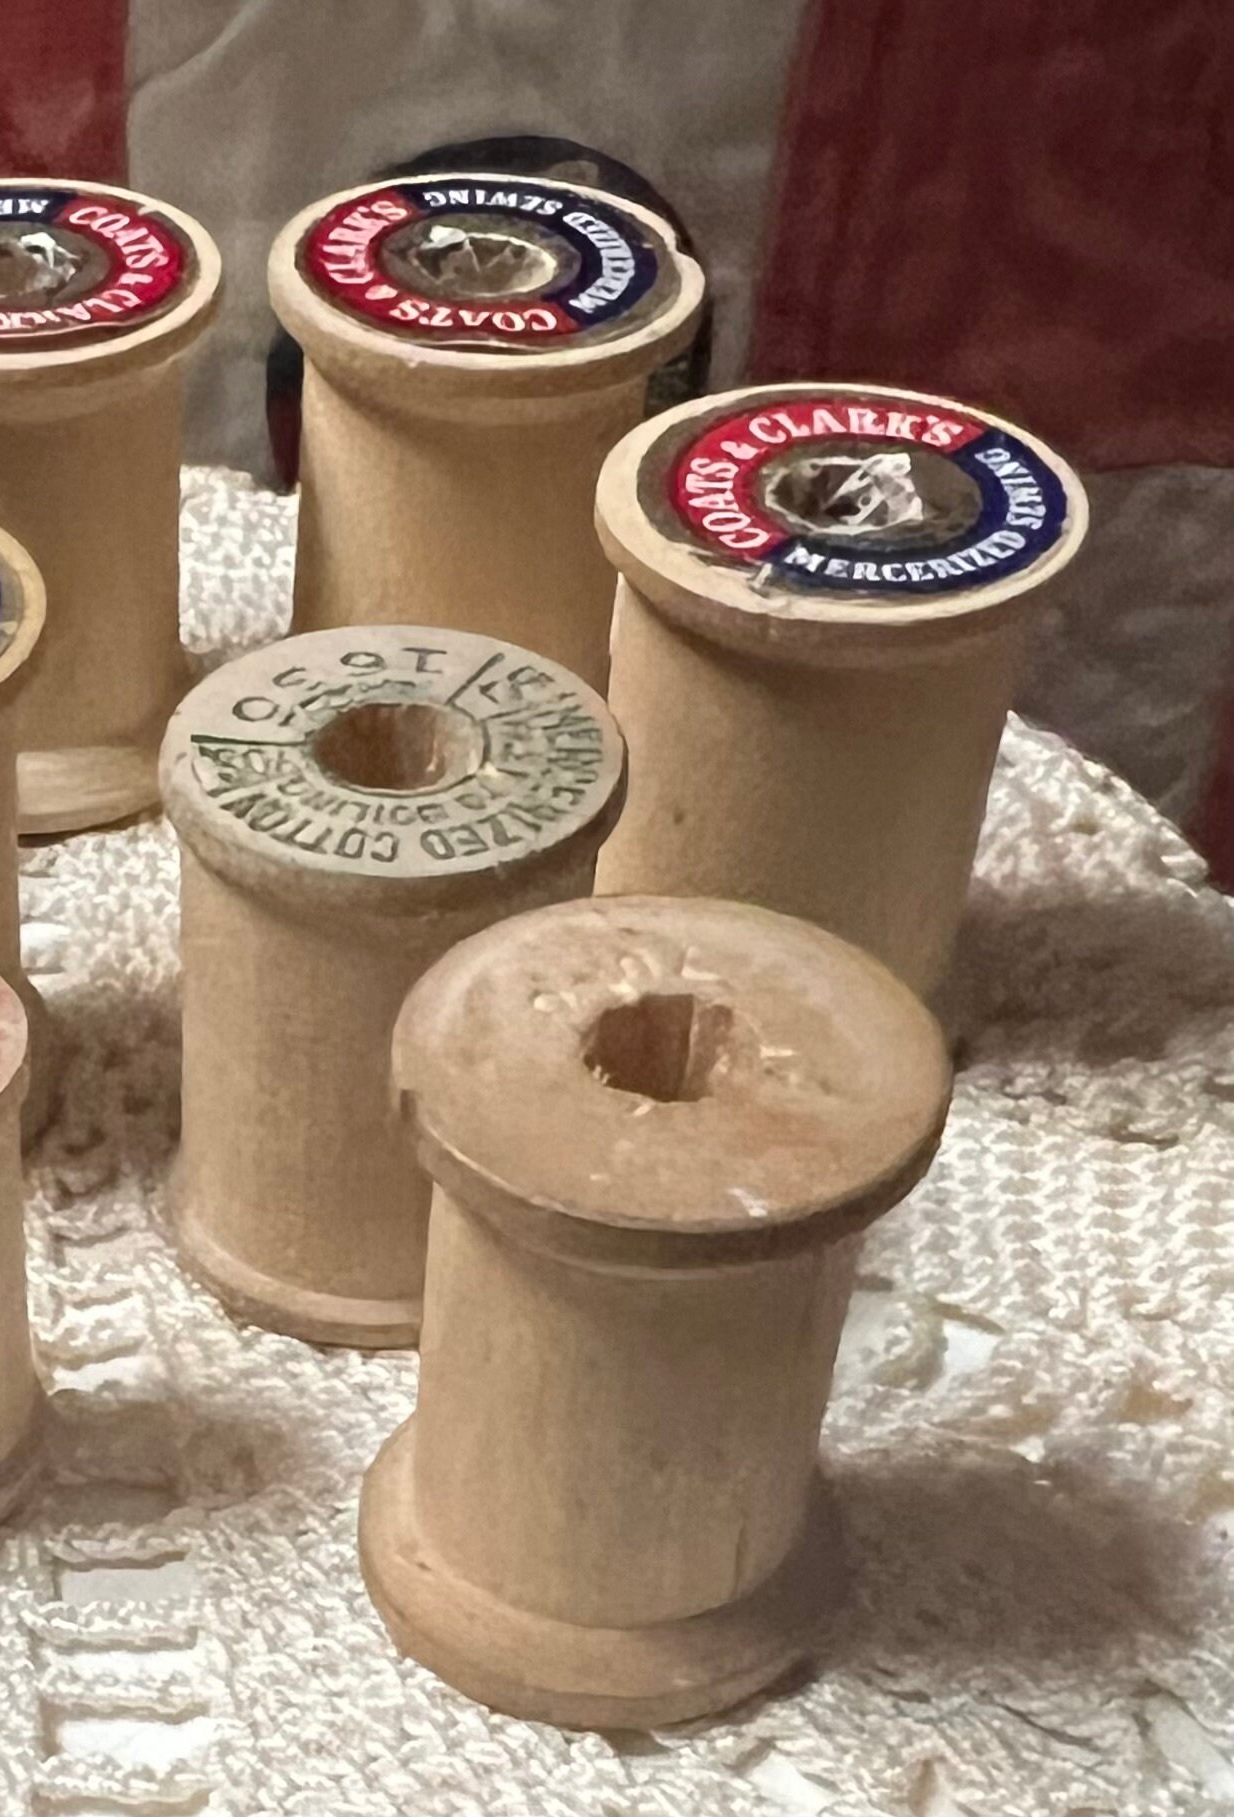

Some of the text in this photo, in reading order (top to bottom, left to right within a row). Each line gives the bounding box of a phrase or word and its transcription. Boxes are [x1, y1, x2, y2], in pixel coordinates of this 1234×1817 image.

[423, 188, 564, 216] SEWING
[68, 206, 169, 269] COATS
[389, 299, 558, 332] COATS
[685, 407, 965, 550] COATS & CLARK'S
[783, 447, 1047, 583] MERCERIZED SEWING
[219, 797, 399, 862] COTTON
